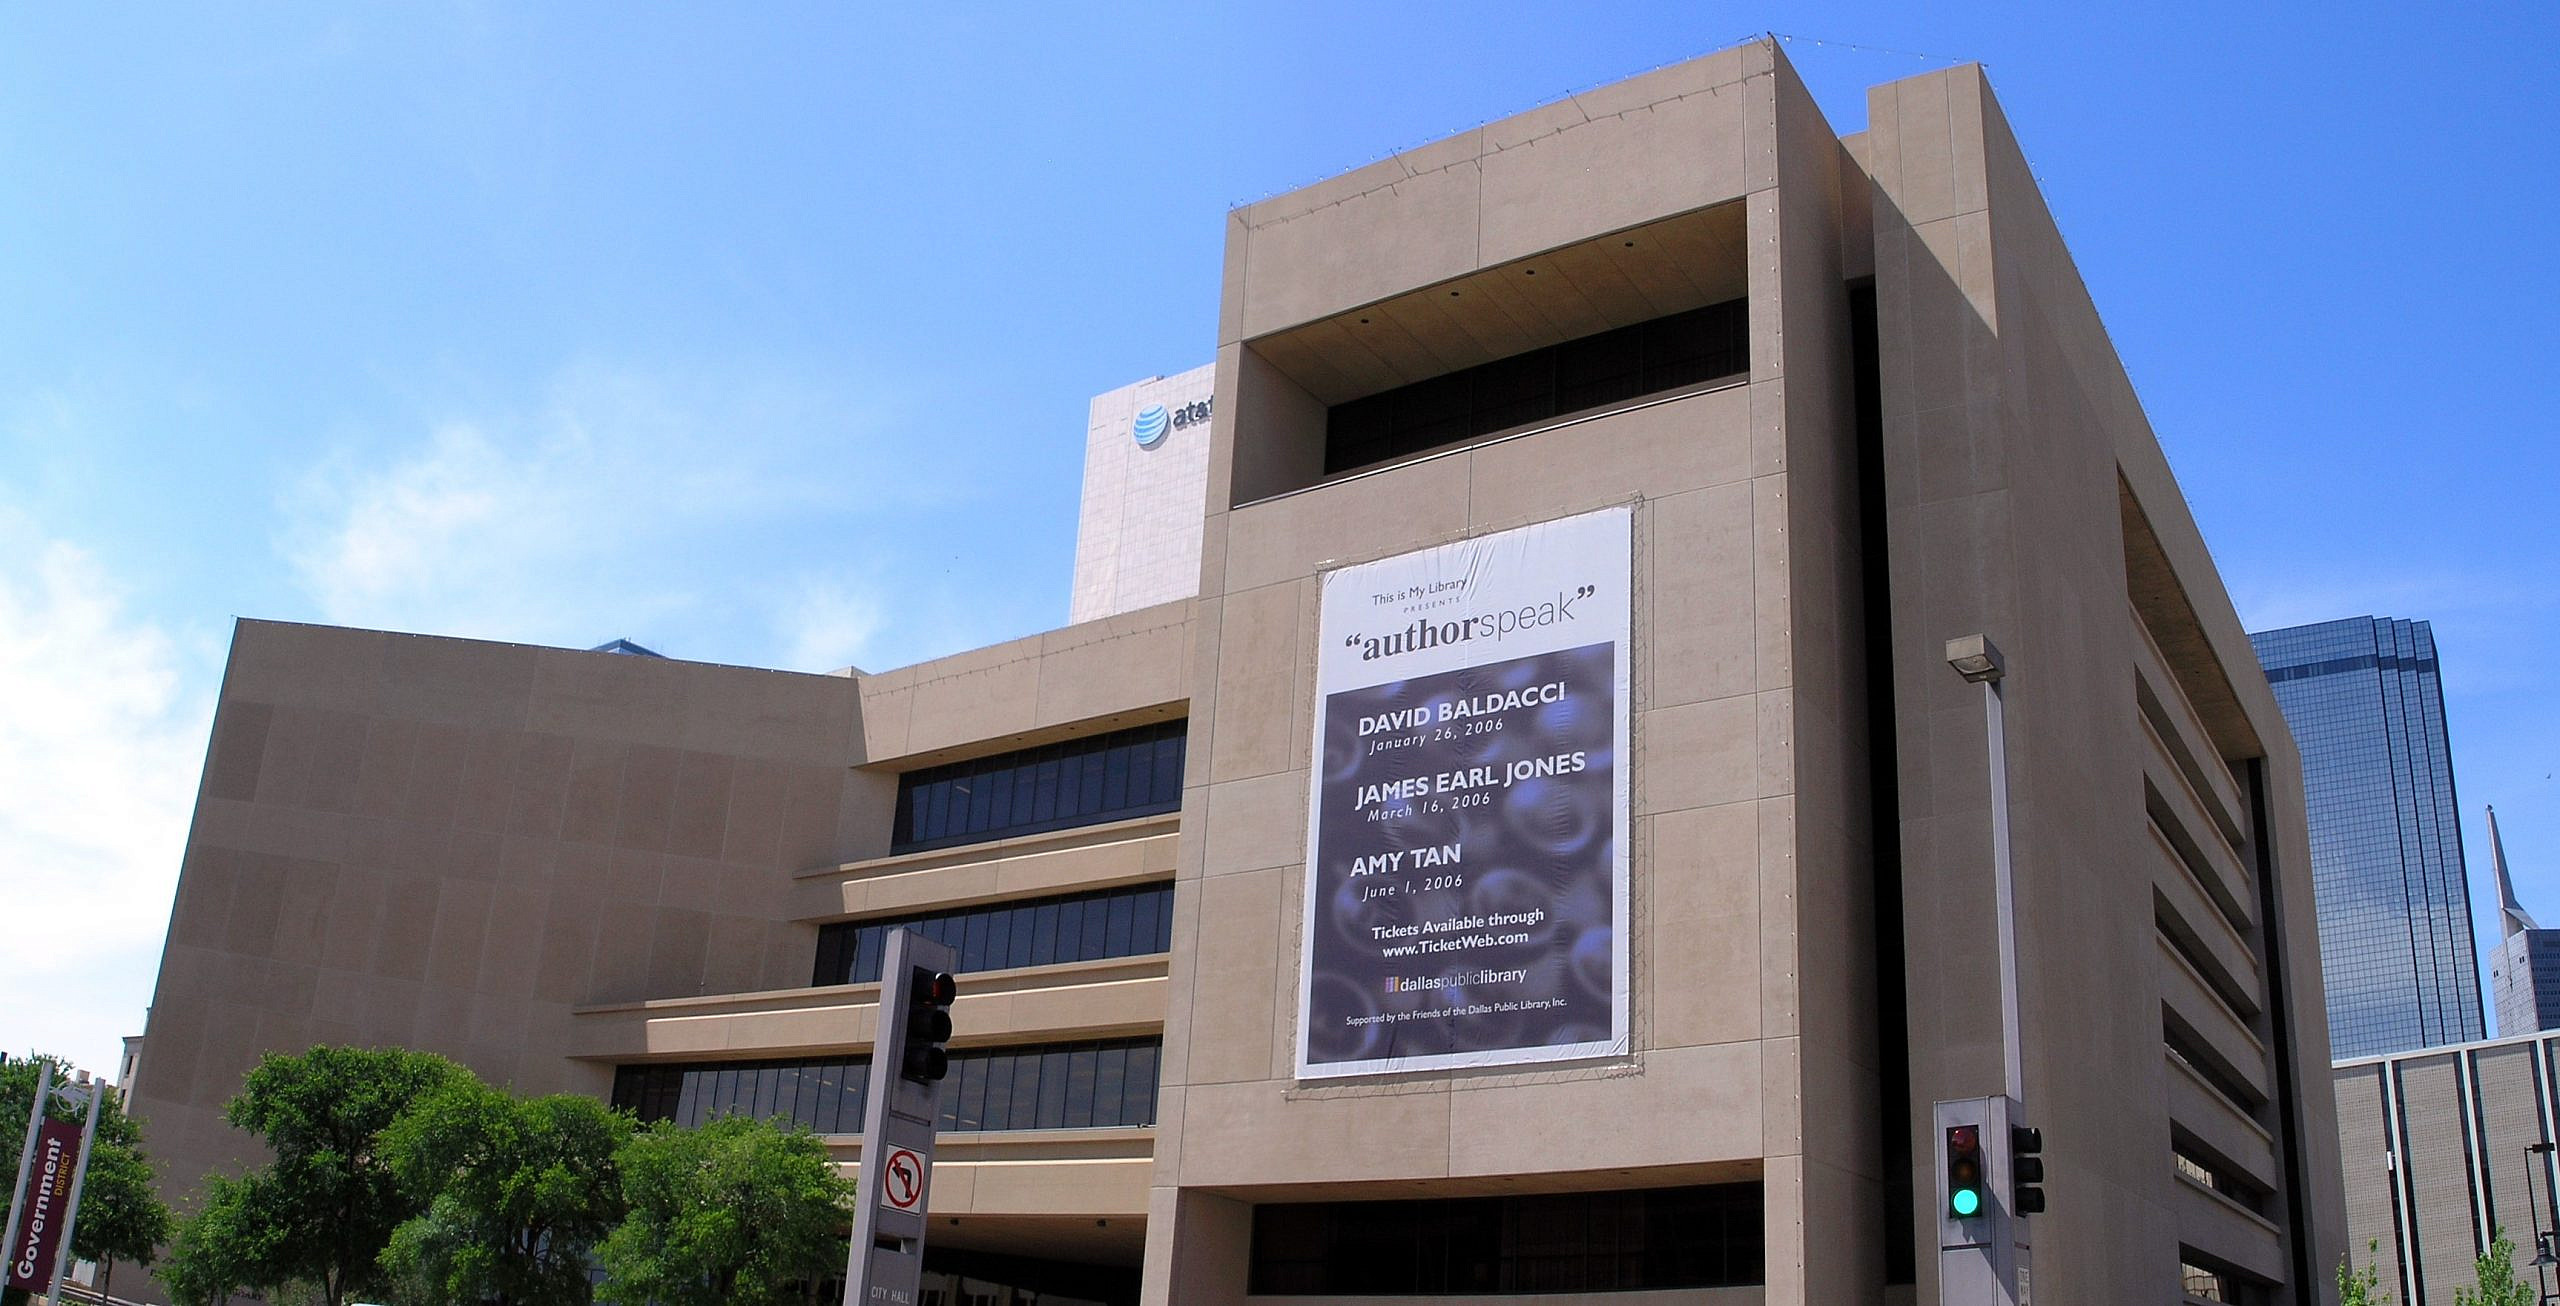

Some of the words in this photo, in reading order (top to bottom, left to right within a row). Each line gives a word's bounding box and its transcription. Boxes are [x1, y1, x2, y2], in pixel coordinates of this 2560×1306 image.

[1372, 593, 1394, 606] This
[1397, 590, 1406, 601] is
[1409, 586, 1426, 599] My
[1429, 578, 1467, 595] Library
[1403, 596, 1461, 613] PRESENTS
[1358, 707, 1431, 737] DAVID
[1438, 681, 1566, 722] BALDACCI
[1369, 733, 1427, 756] January
[1434, 727, 1457, 742] 26,
[1465, 718, 1504, 736] 2006
[1355, 777, 1429, 811] JAMES
[1436, 766, 1499, 794] EARL
[1503, 751, 1586, 788] JONES
[1367, 804, 1412, 822] March
[1422, 800, 1444, 814] 16,
[1452, 791, 1491, 810] 2006
[1350, 851, 1404, 877] AMY
[1410, 843, 1462, 869] TAN
[1362, 886, 1395, 902] June
[1405, 881, 1417, 894] 1,
[1424, 874, 1463, 891] 2006
[1372, 924, 1419, 940] Tickets
[1422, 915, 1485, 935] Available
[1488, 908, 1544, 927] through
[1382, 931, 1529, 958] www.TicketWeb.com
[1400, 968, 1527, 992] dallaspubliclibrary
[1346, 1012, 1385, 1027] Supported
[1386, 1012, 1395, 1024] by
[1397, 1012, 1411, 1021] the
[1412, 1008, 1440, 1019] Friends
[1442, 1007, 1452, 1016] of
[1453, 1006, 1466, 1016] the
[1468, 1004, 1492, 1014] Dallas
[1494, 1001, 1518, 1012] Public
[1520, 999, 1551, 1010] Library,
[1552, 997, 1567, 1007] Inc.
[54, 1152, 71, 1196] DISTRICT
[17, 1137, 62, 1280] Government
[871, 1286, 887, 1300] CITY
[891, 1289, 910, 1304] HALL
